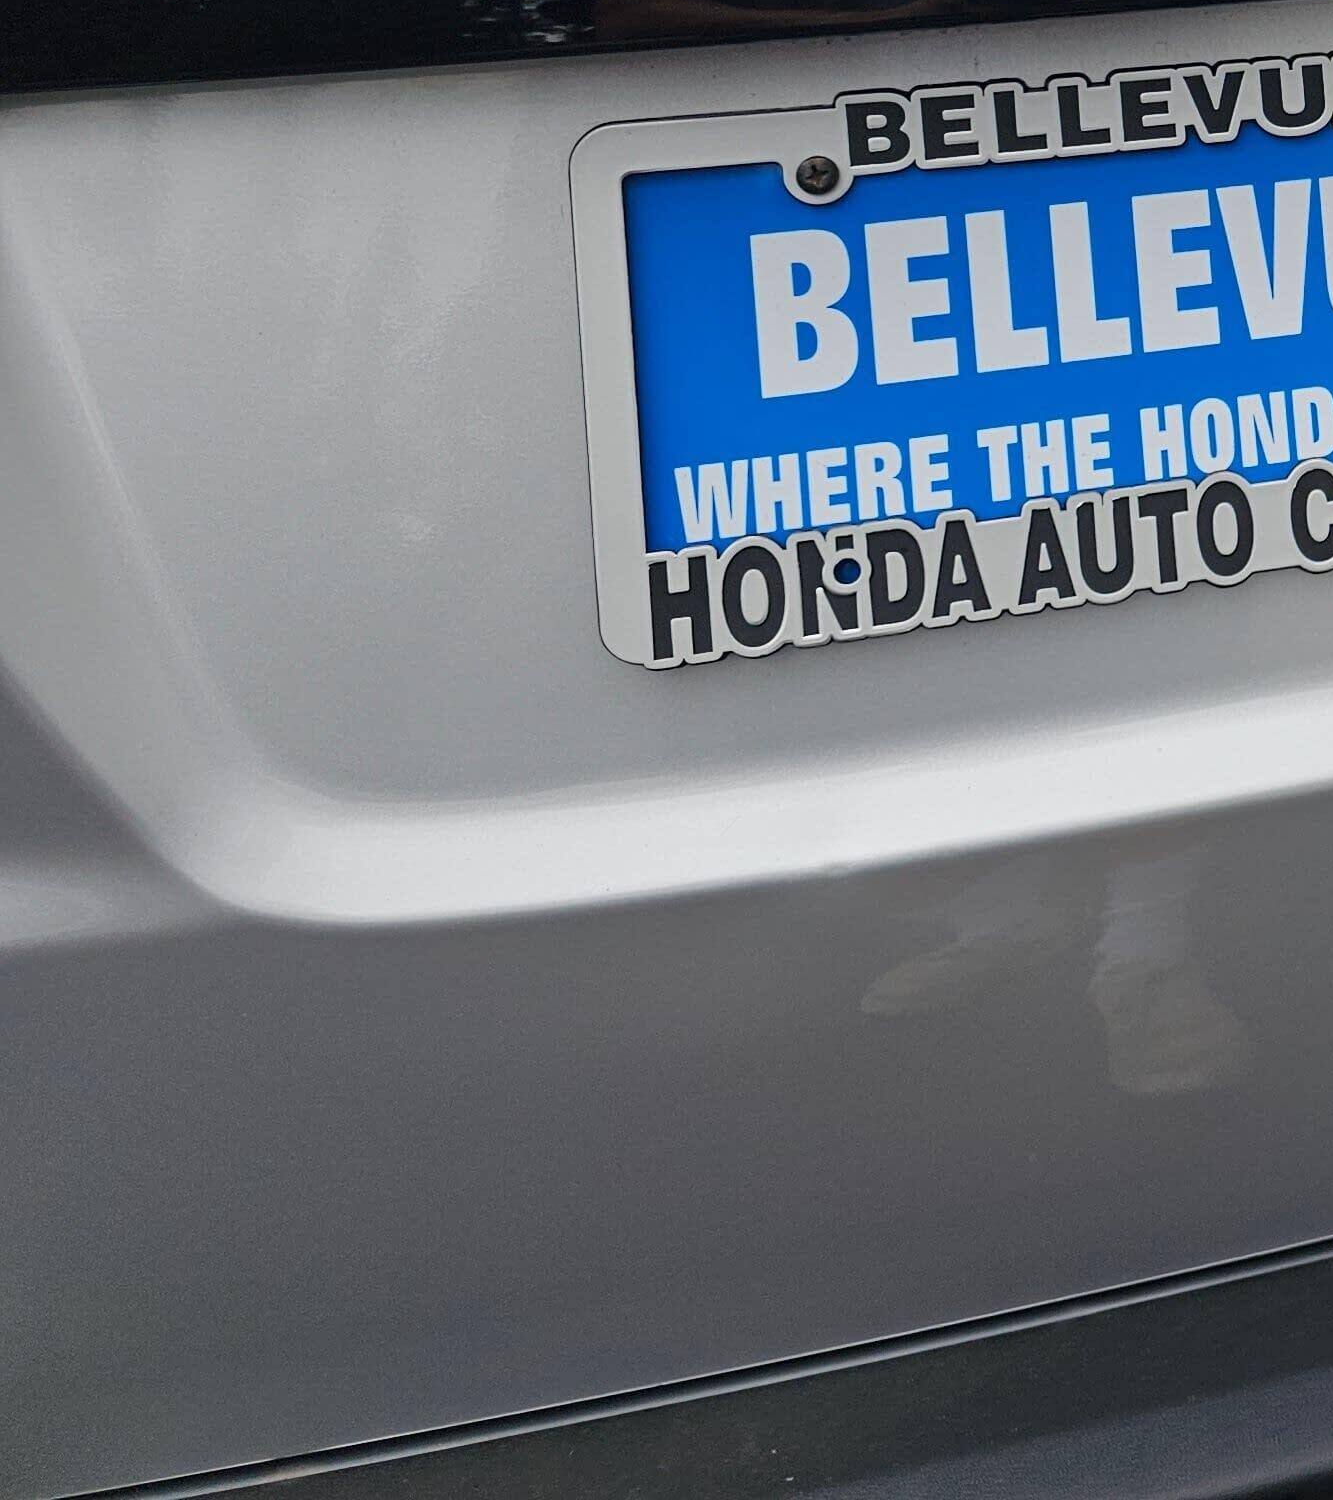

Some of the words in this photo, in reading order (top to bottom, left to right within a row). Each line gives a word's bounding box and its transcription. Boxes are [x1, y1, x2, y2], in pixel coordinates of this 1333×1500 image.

[674, 434, 954, 543] WHERE
[976, 413, 1115, 502] THE
[648, 519, 991, 662] HONDA
[1018, 480, 1255, 605] AUTO
